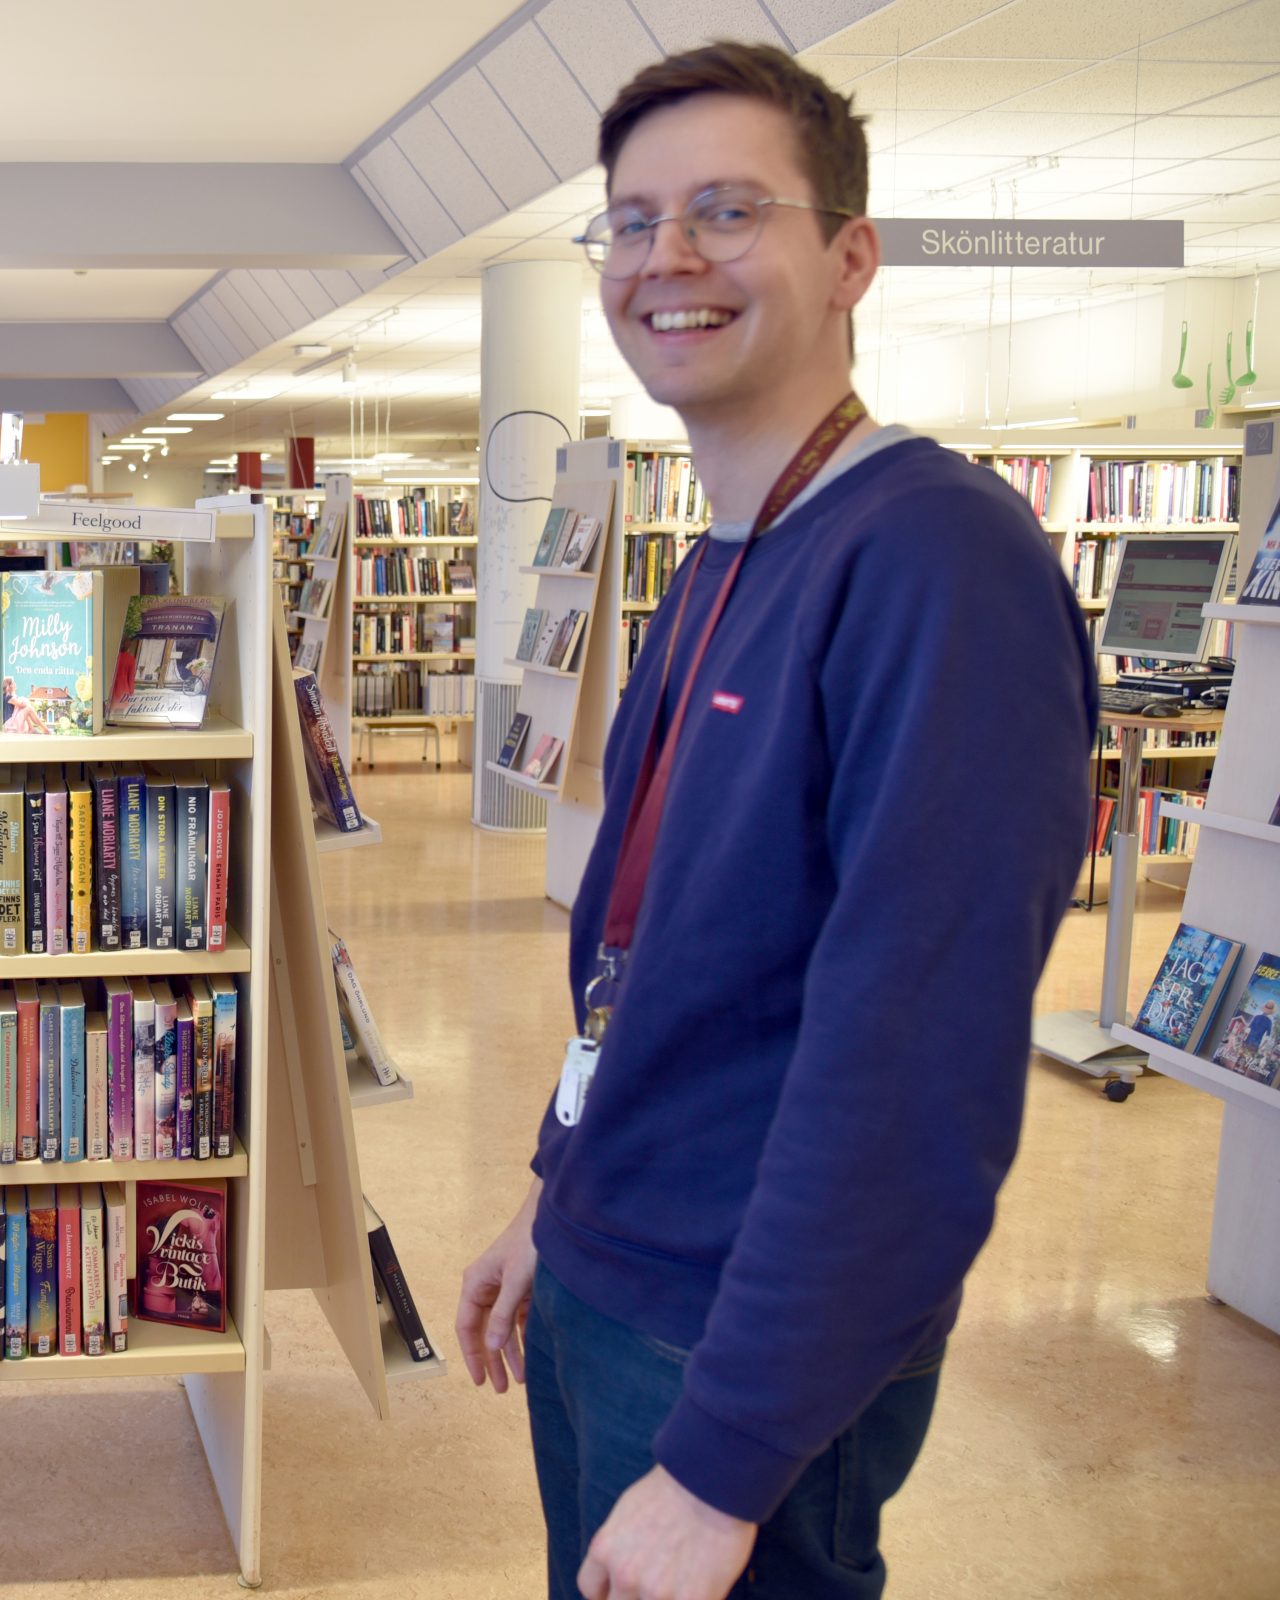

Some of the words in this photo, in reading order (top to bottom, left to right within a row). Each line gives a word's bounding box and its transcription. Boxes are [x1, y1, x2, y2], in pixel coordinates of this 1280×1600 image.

[921, 229, 1105, 256] Skönlitteratur
[71, 511, 142, 532] Feelgood
[1242, 570, 1280, 599] KIN
[22, 612, 73, 641] Milly
[9, 635, 82, 665] Johnson
[16, 666, 32, 675] Den
[33, 666, 53, 675] enda
[54, 665, 75, 676] rätta
[125, 703, 166, 718] faktiskt
[306, 683, 321, 716] Simona
[101, 789, 115, 817] LIANE
[127, 784, 140, 810] LIANE
[157, 796, 165, 812] DIN
[187, 796, 196, 814] NIO
[32, 823, 40, 835] som
[78, 804, 86, 837] SARAH
[216, 809, 224, 829] JOJO
[10, 821, 20, 854] Mhairi
[102, 820, 116, 870] MORIARTY
[127, 813, 140, 861] MORIARTY
[187, 817, 197, 881] FRÄMLINGAR
[78, 839, 86, 885] MORGAN
[154, 886, 162, 929] MORIARTY
[161, 895, 169, 919] LIANE
[184, 887, 192, 930] MORIARTY
[191, 896, 199, 920] LIANE
[1167, 954, 1206, 983] JAG
[347, 972, 357, 989] DAG
[354, 990, 370, 1024] ÖHRLUND
[1158, 978, 1192, 1010] SER
[1144, 998, 1188, 1032] DIG
[69, 1058, 81, 1098] Delicious!
[144, 1193, 177, 1208] ISABEL
[180, 1194, 216, 1217] WOLFF
[146, 1209, 204, 1255] Vickis
[32, 1241, 46, 1273] Wiggs
[45, 1243, 55, 1269] Susan
[84, 1246, 92, 1274] KATTEN
[91, 1246, 99, 1289] SOMMAREN
[160, 1246, 212, 1265] vintage
[151, 1261, 208, 1293] Butik
[86, 1276, 95, 1310] FLYTTADE
[392, 1273, 405, 1299] MARCUS
[402, 1298, 412, 1315] PALM
